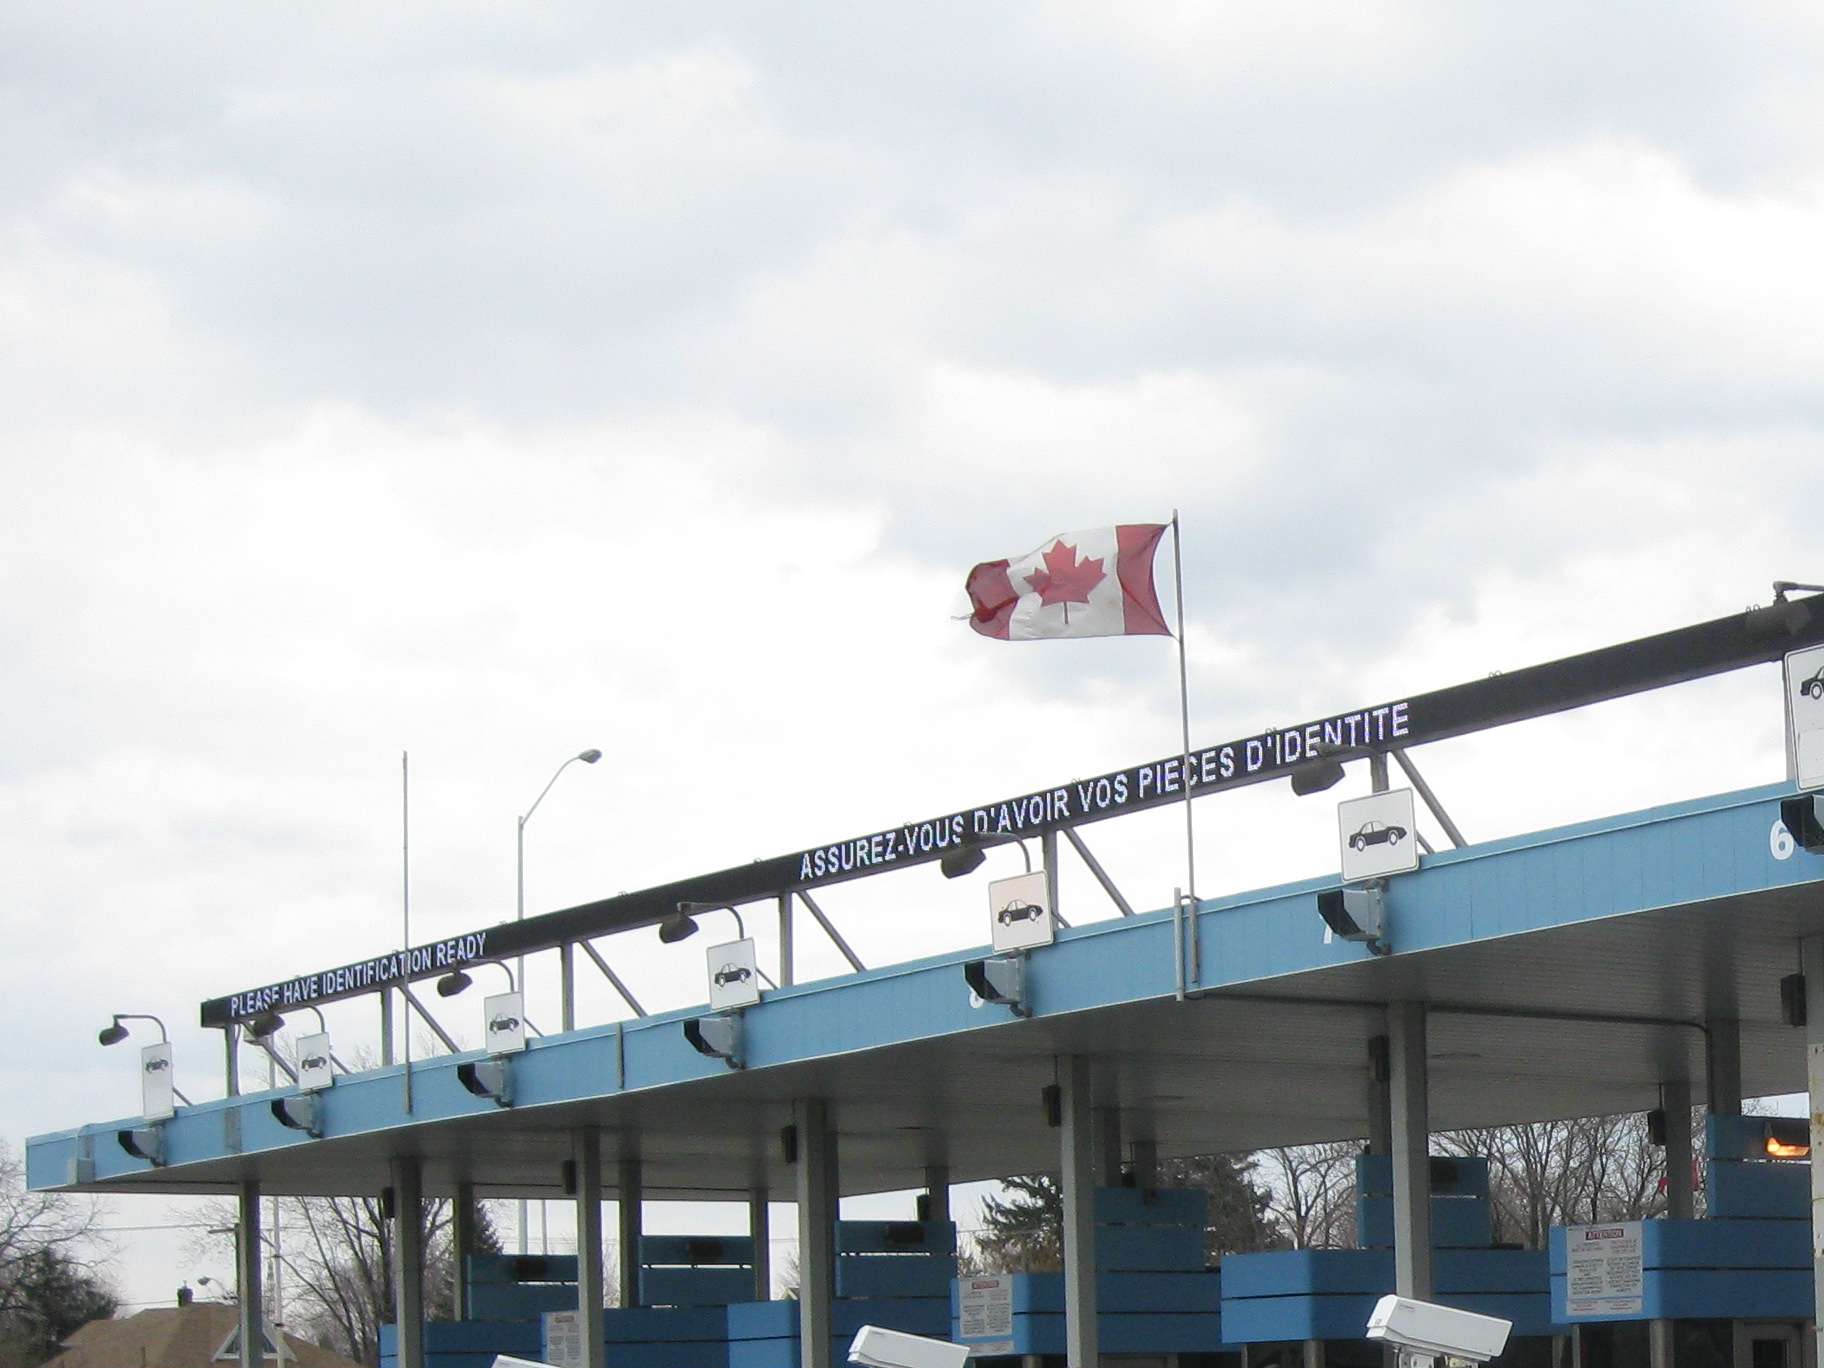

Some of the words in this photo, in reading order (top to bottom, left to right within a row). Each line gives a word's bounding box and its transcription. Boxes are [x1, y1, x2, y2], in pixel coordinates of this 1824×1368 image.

[800, 815, 964, 880] ASSUREZ-VOUS
[974, 788, 1071, 834] D'AVOIR
[1078, 774, 1128, 813] VOS
[1139, 747, 1234, 798] PIECES
[1246, 702, 1409, 772] D'IDENTITE
[1770, 819, 1794, 860] 6
[283, 976, 318, 1004] HAVE
[322, 947, 432, 995] IDENTIFICATION
[437, 932, 487, 967] READY
